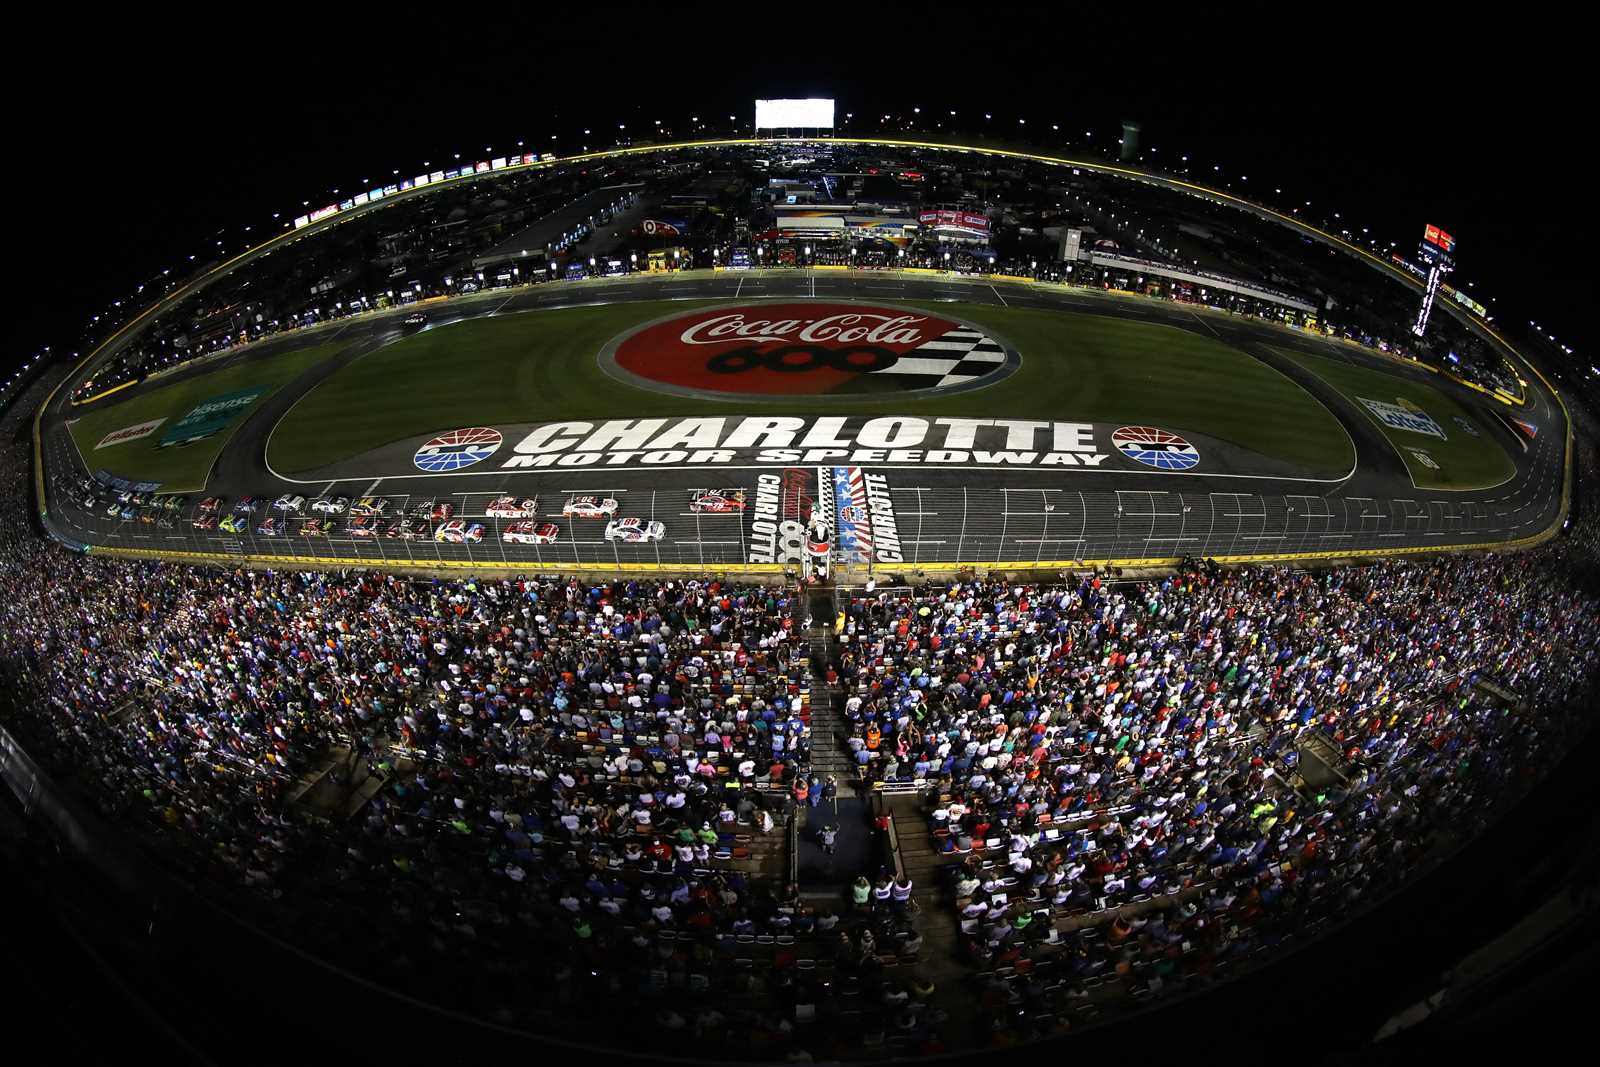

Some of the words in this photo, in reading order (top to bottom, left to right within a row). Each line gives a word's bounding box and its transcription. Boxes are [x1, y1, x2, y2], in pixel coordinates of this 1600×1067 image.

[680, 313, 928, 344] Coca-Cola
[707, 345, 899, 373] 600
[513, 416, 1096, 453] CHARLOTTE
[501, 449, 737, 469] MOTOR
[756, 448, 1110, 467] SPEEDWAY
[749, 474, 782, 563] CHARLOTTE
[863, 473, 904, 563] CHARLOTTE
